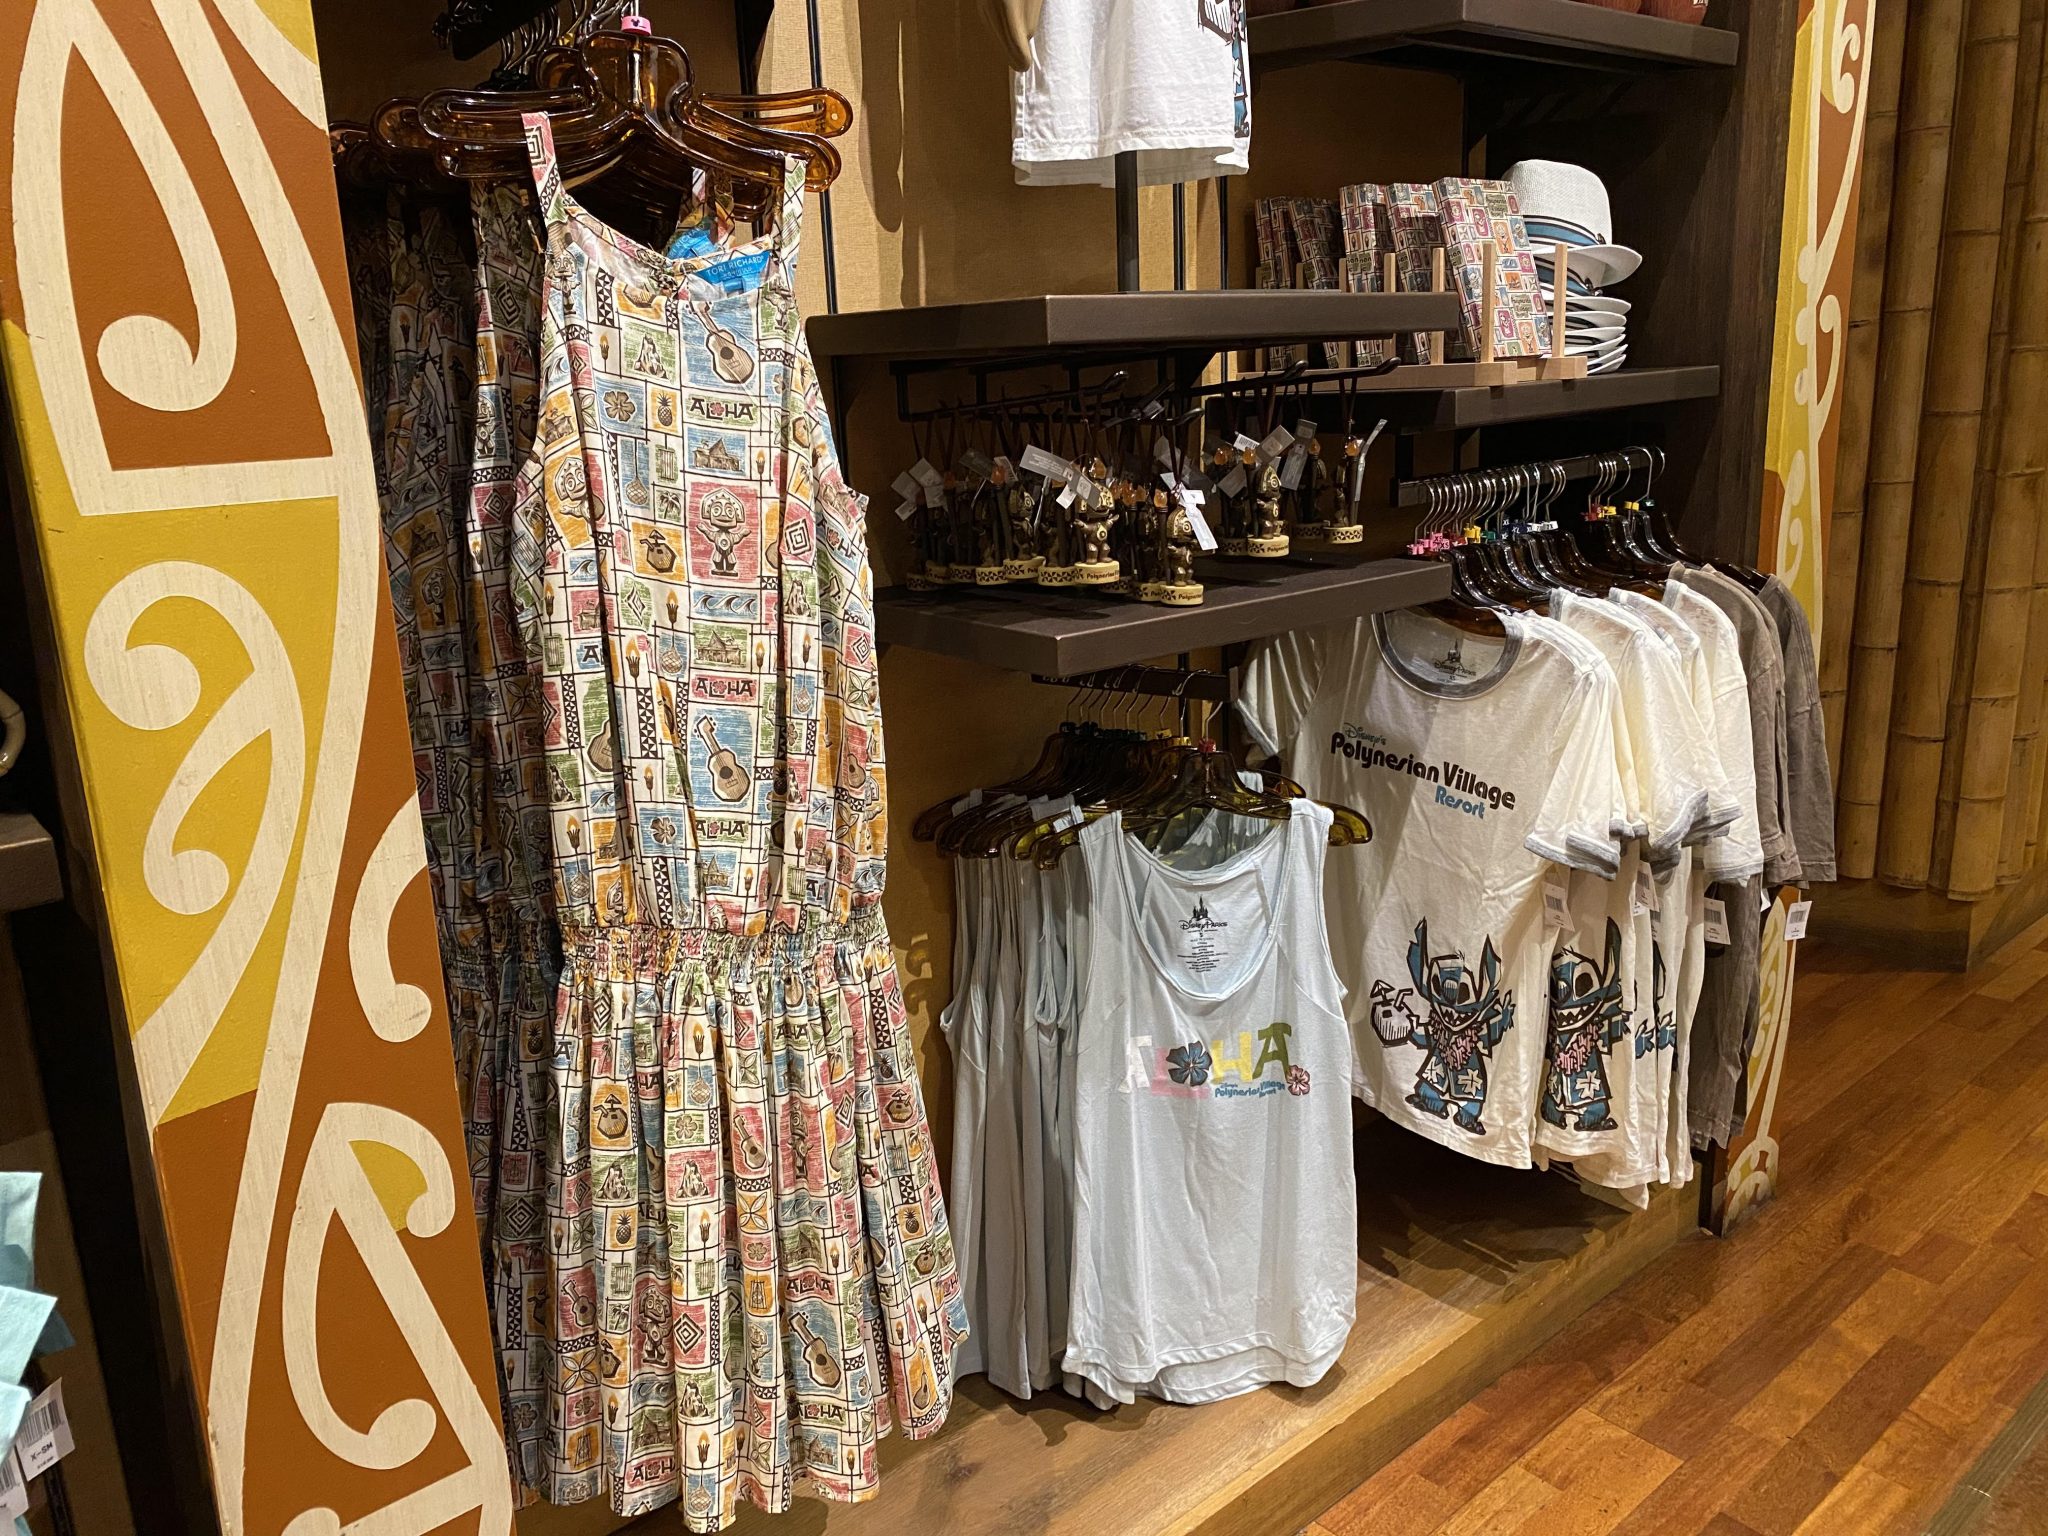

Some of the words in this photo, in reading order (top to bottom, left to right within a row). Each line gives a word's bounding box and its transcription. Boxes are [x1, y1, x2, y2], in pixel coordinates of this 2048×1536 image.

[706, 264, 727, 276] TORI
[729, 256, 762, 268] RICHARD
[1343, 722, 1387, 747] Disney's
[1330, 732, 1439, 783] Polynesian
[1443, 761, 1516, 810] Village
[1434, 784, 1486, 820] Resort
